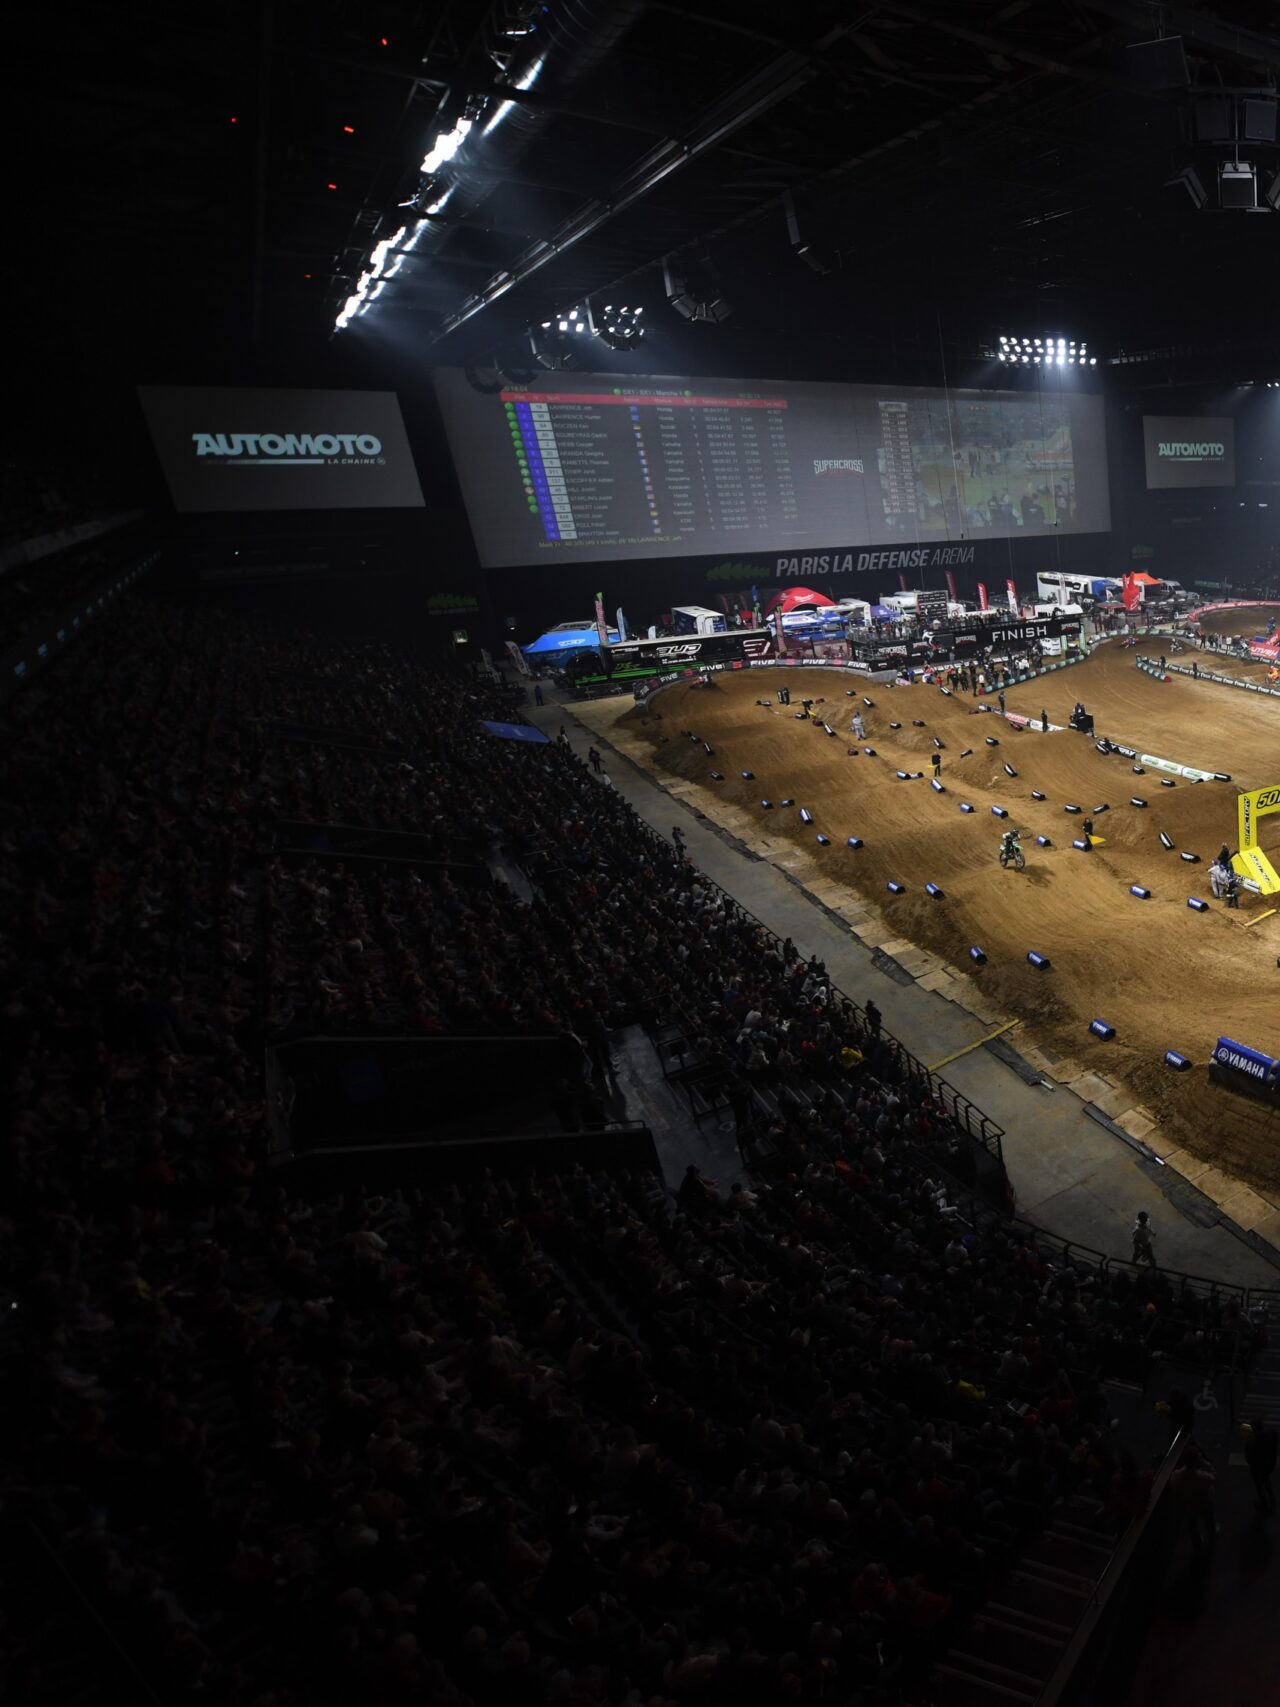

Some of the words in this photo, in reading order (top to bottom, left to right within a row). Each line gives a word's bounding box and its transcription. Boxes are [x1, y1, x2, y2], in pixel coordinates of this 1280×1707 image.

[192, 433, 381, 456] AUTOMOTO
[1158, 442, 1224, 456] AUTOMOTO
[813, 459, 865, 474] SUPERCROSS
[775, 554, 830, 577] PARIS
[832, 553, 853, 574] LA
[857, 549, 931, 571] DEFENSE
[930, 546, 976, 566] ARENA
[992, 626, 1047, 642] FINISH
[699, 663, 724, 672] FIVE
[660, 672, 678, 682] FIVE
[1228, 1051, 1265, 1079] YAMAHA
